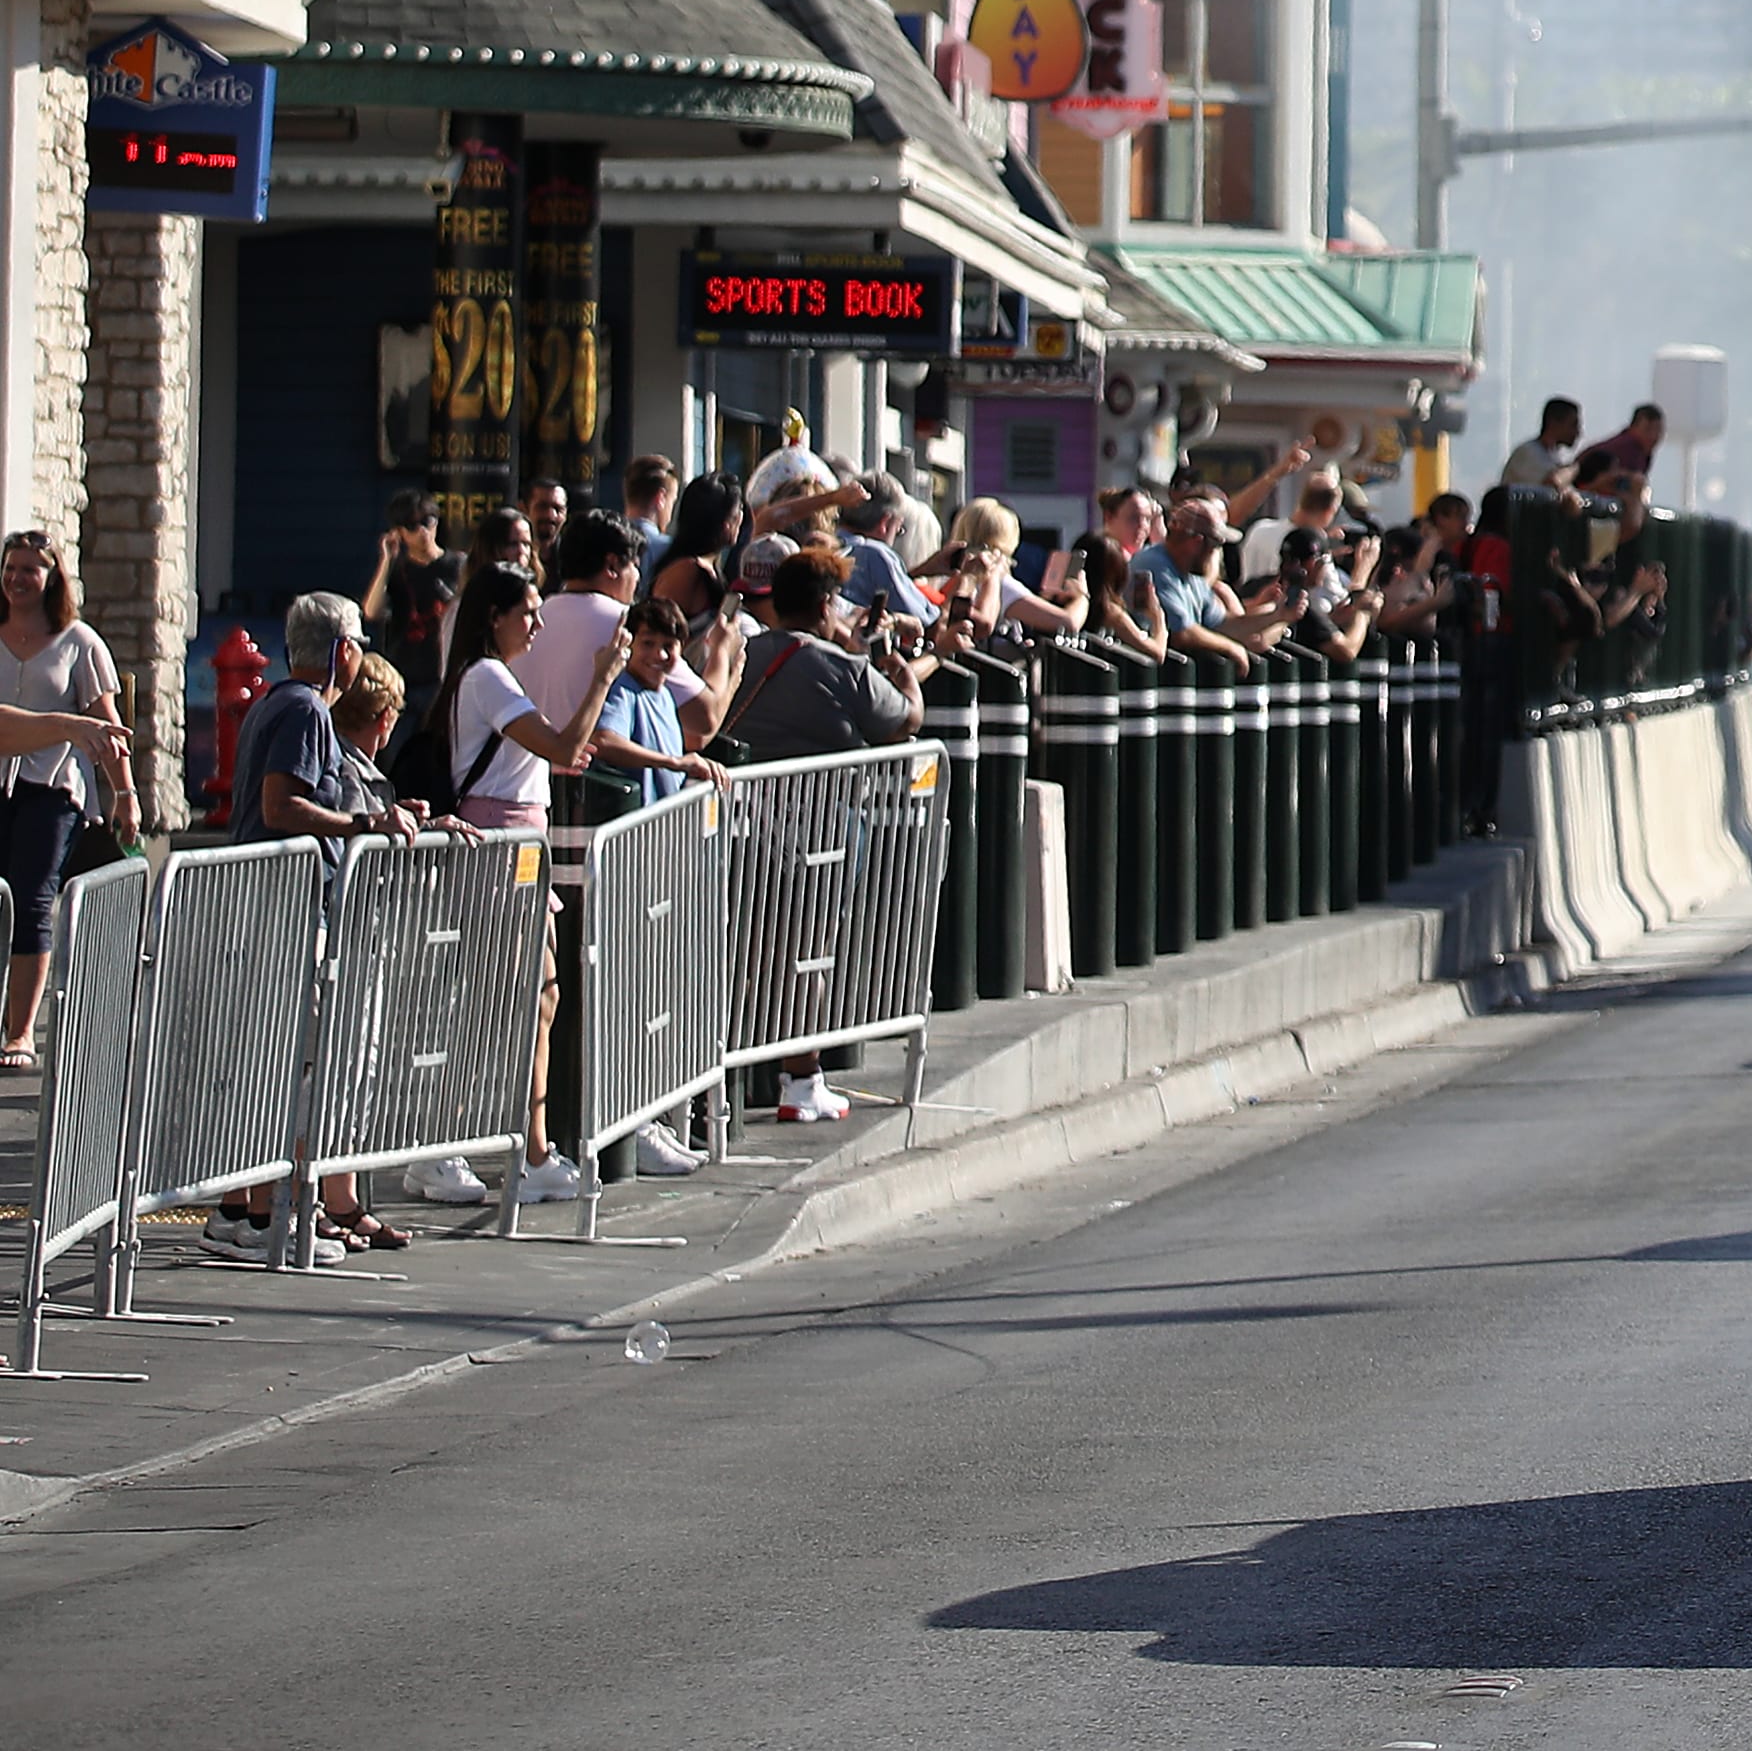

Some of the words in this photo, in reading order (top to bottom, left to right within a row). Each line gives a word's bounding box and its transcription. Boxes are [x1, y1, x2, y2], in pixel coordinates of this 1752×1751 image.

[87, 64, 145, 99] hite
[155, 72, 254, 106] Castle
[440, 206, 509, 246] FREE
[434, 267, 460, 297] THE
[465, 267, 515, 298] FIRST
[705, 275, 827, 317] SPORTS
[843, 278, 925, 319] BOOK
